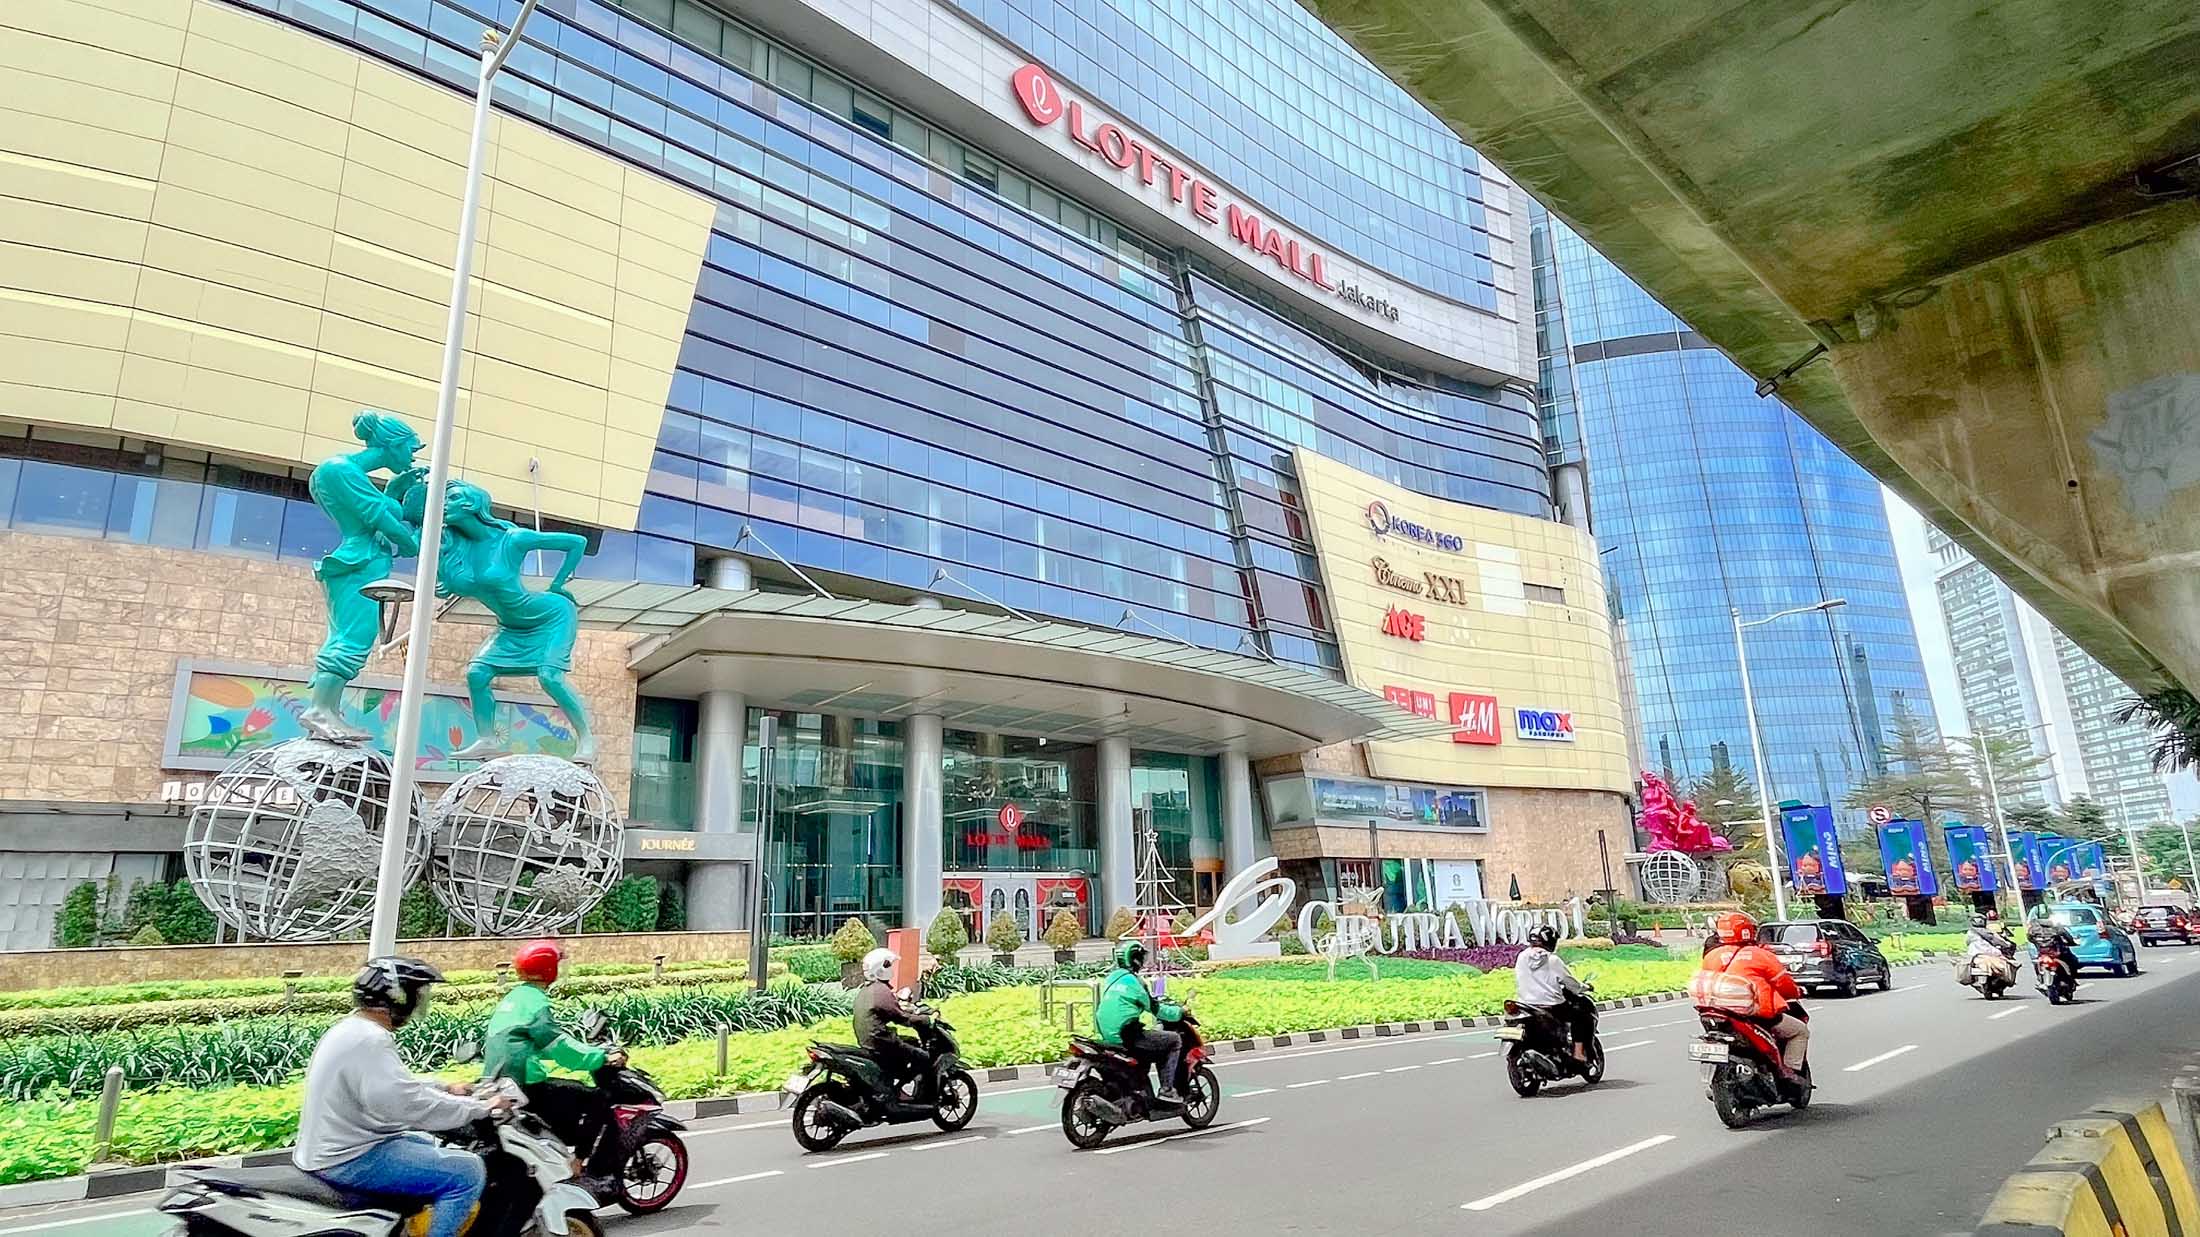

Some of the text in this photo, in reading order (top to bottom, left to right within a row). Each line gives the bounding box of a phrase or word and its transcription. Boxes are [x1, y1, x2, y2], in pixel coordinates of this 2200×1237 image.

[1068, 100, 1400, 322] LOTTE MALL Jakarta
[1392, 515, 1435, 544] KOREA
[1424, 571, 1468, 605] XXI
[1382, 602, 1425, 642] ACE
[1518, 710, 1574, 732] max
[1297, 900, 1468, 956] CIPUTRA
[1464, 900, 1569, 948] WORLD
